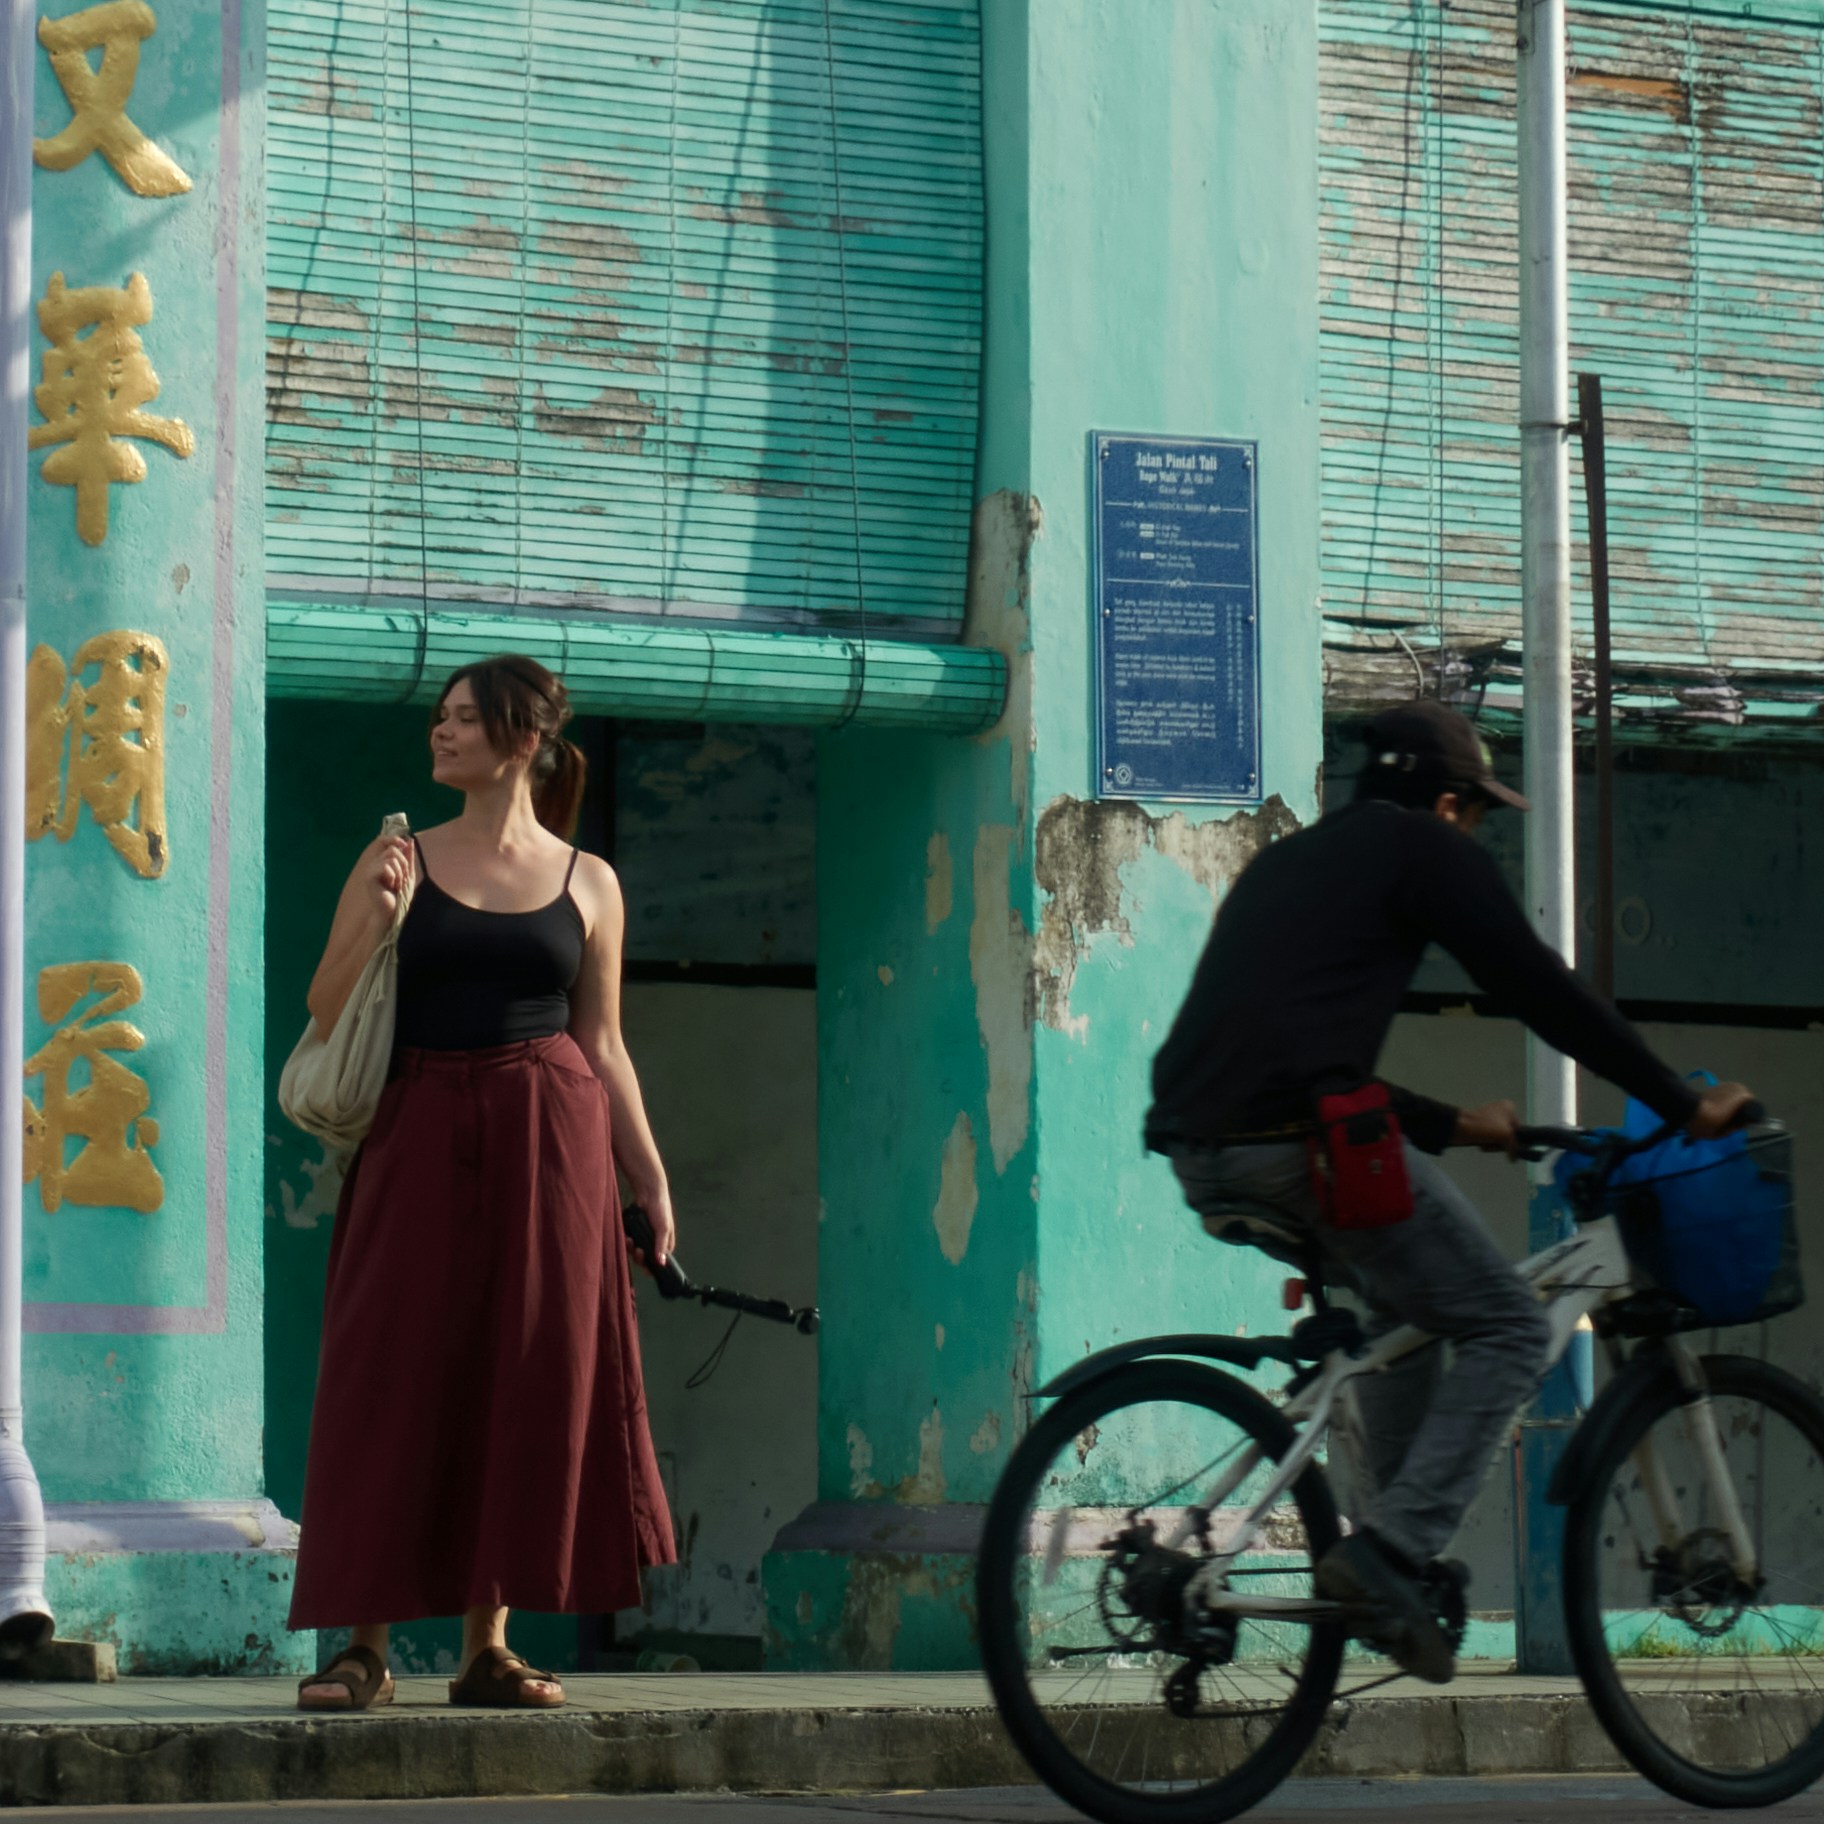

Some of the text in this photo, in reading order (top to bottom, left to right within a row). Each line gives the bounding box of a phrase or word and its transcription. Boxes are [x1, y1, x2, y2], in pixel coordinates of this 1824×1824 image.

[1136, 452, 1218, 470] Jalan Pintal Tali
